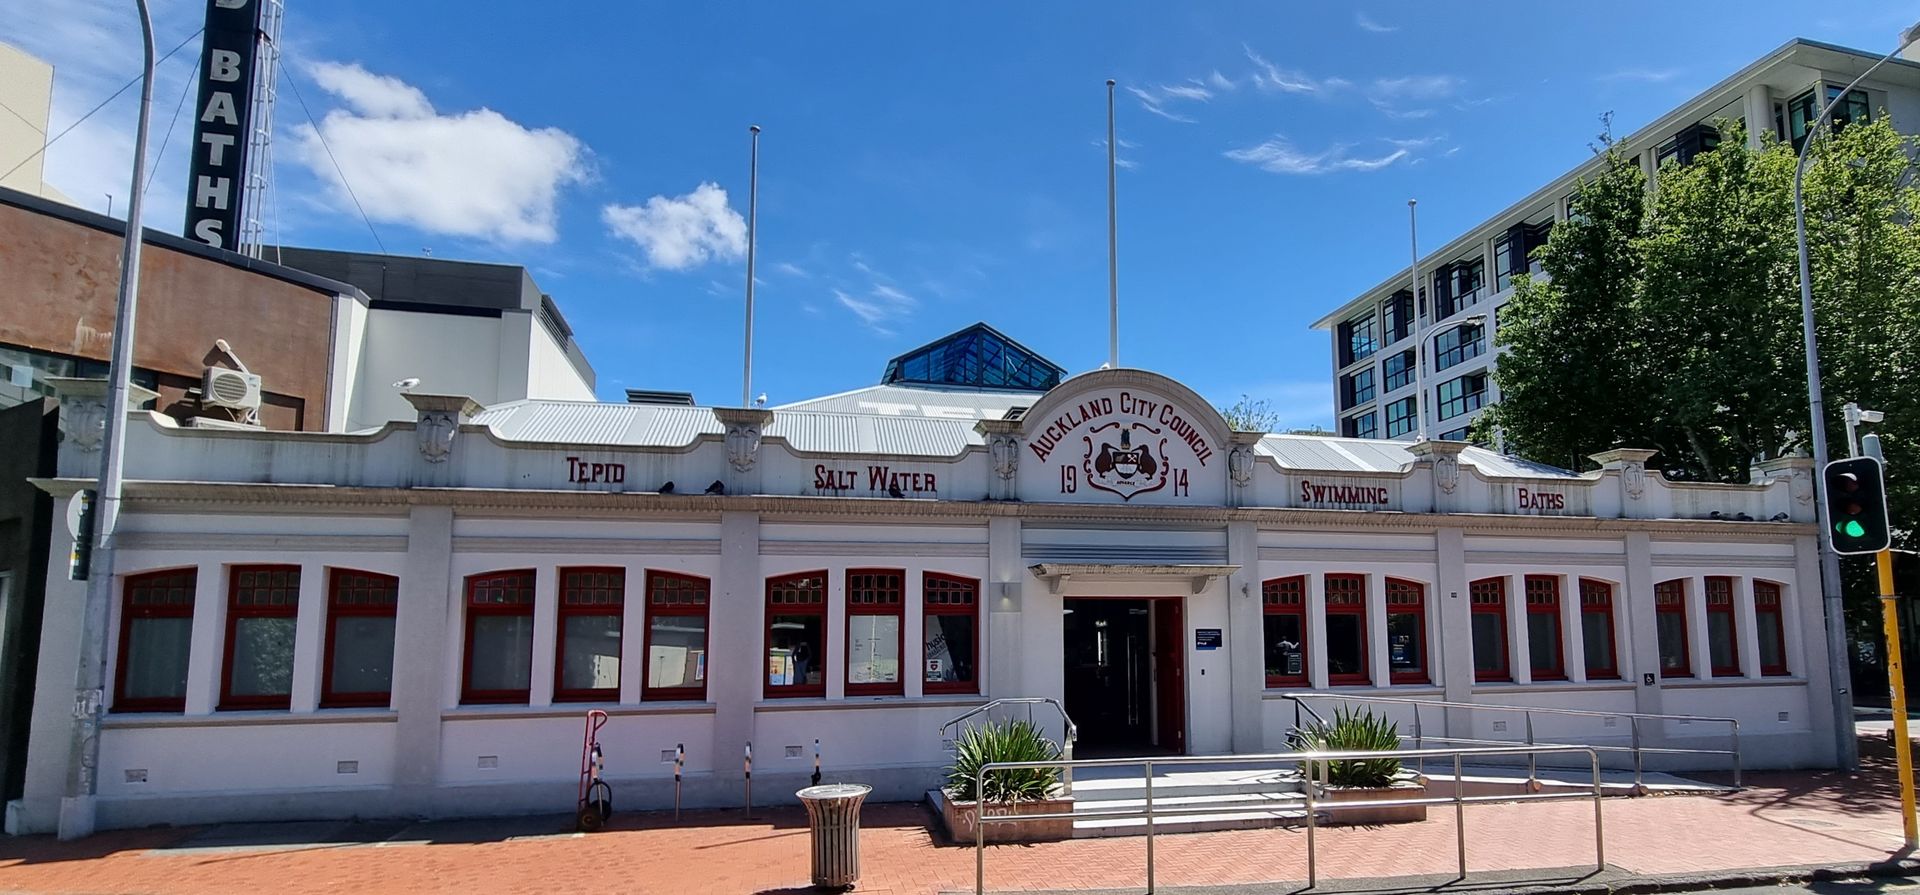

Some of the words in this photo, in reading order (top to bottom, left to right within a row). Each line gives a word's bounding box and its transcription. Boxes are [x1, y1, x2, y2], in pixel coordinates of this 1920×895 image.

[195, 48, 241, 249] BATHS
[1029, 397, 1113, 463] AUCKLAND
[1120, 392, 1158, 419] CITY
[1159, 404, 1213, 467] COUNCIL
[567, 456, 625, 483] TEPID
[814, 464, 858, 490] SALT
[867, 466, 937, 492] WATER
[1060, 465, 1077, 494] 19
[1173, 468, 1189, 497] 14
[1301, 480, 1389, 505] SWIMMING
[1518, 488, 1565, 509] BATHS
